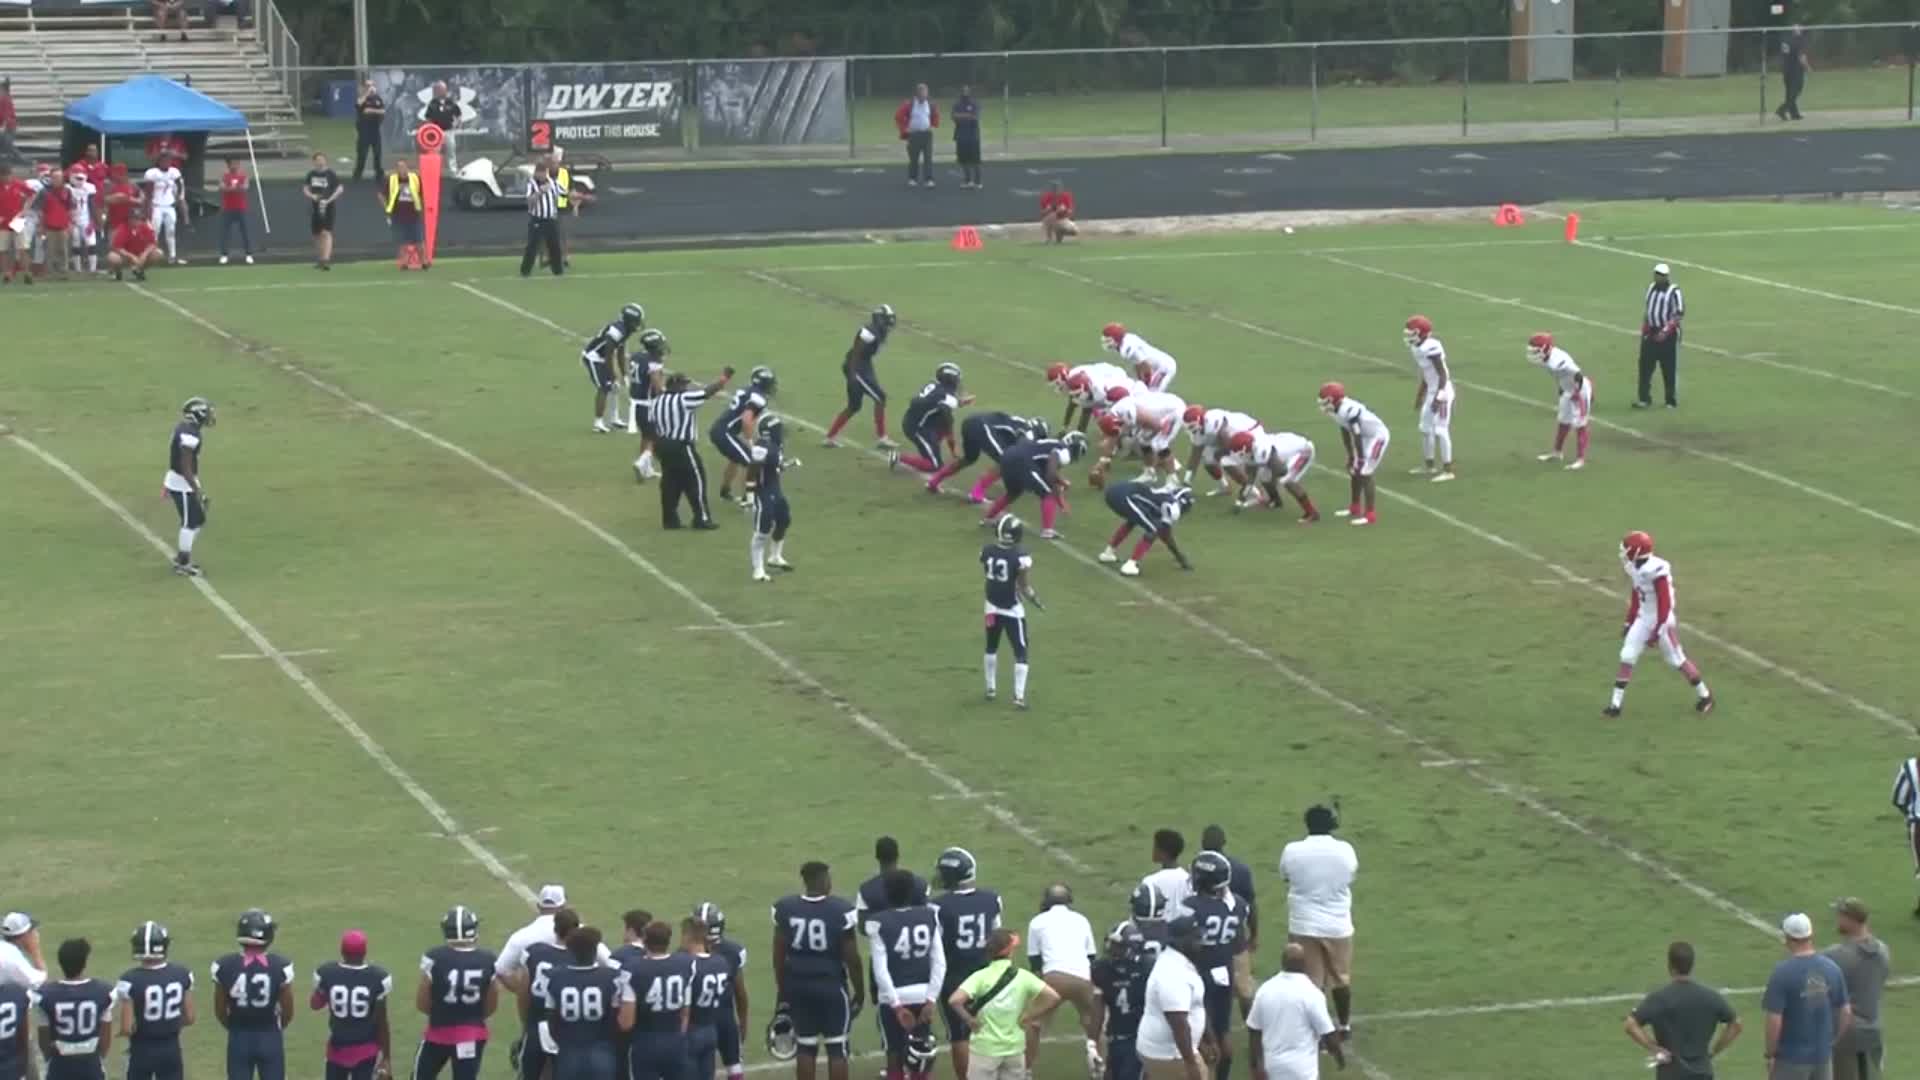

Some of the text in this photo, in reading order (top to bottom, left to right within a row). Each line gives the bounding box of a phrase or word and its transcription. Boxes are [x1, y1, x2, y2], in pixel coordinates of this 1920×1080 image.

[546, 82, 672, 110] DWYER
[531, 121, 551, 149] 2
[555, 126, 600, 139] PROTECT
[1504, 207, 1516, 224] G
[986, 557, 1008, 582] 13
[789, 917, 827, 951] 78
[895, 924, 930, 960] 49
[956, 914, 986, 948] 51
[1202, 916, 1239, 946] 26
[144, 982, 182, 1021] 82
[229, 973, 271, 1007] 43
[329, 985, 370, 1018] 86
[443, 969, 483, 1004] 15
[647, 976, 684, 1011] 40
[697, 972, 728, 1008] 65
[1116, 987, 1130, 1014] 4
[54, 1001, 97, 1035] 50
[561, 986, 603, 1022] 88
